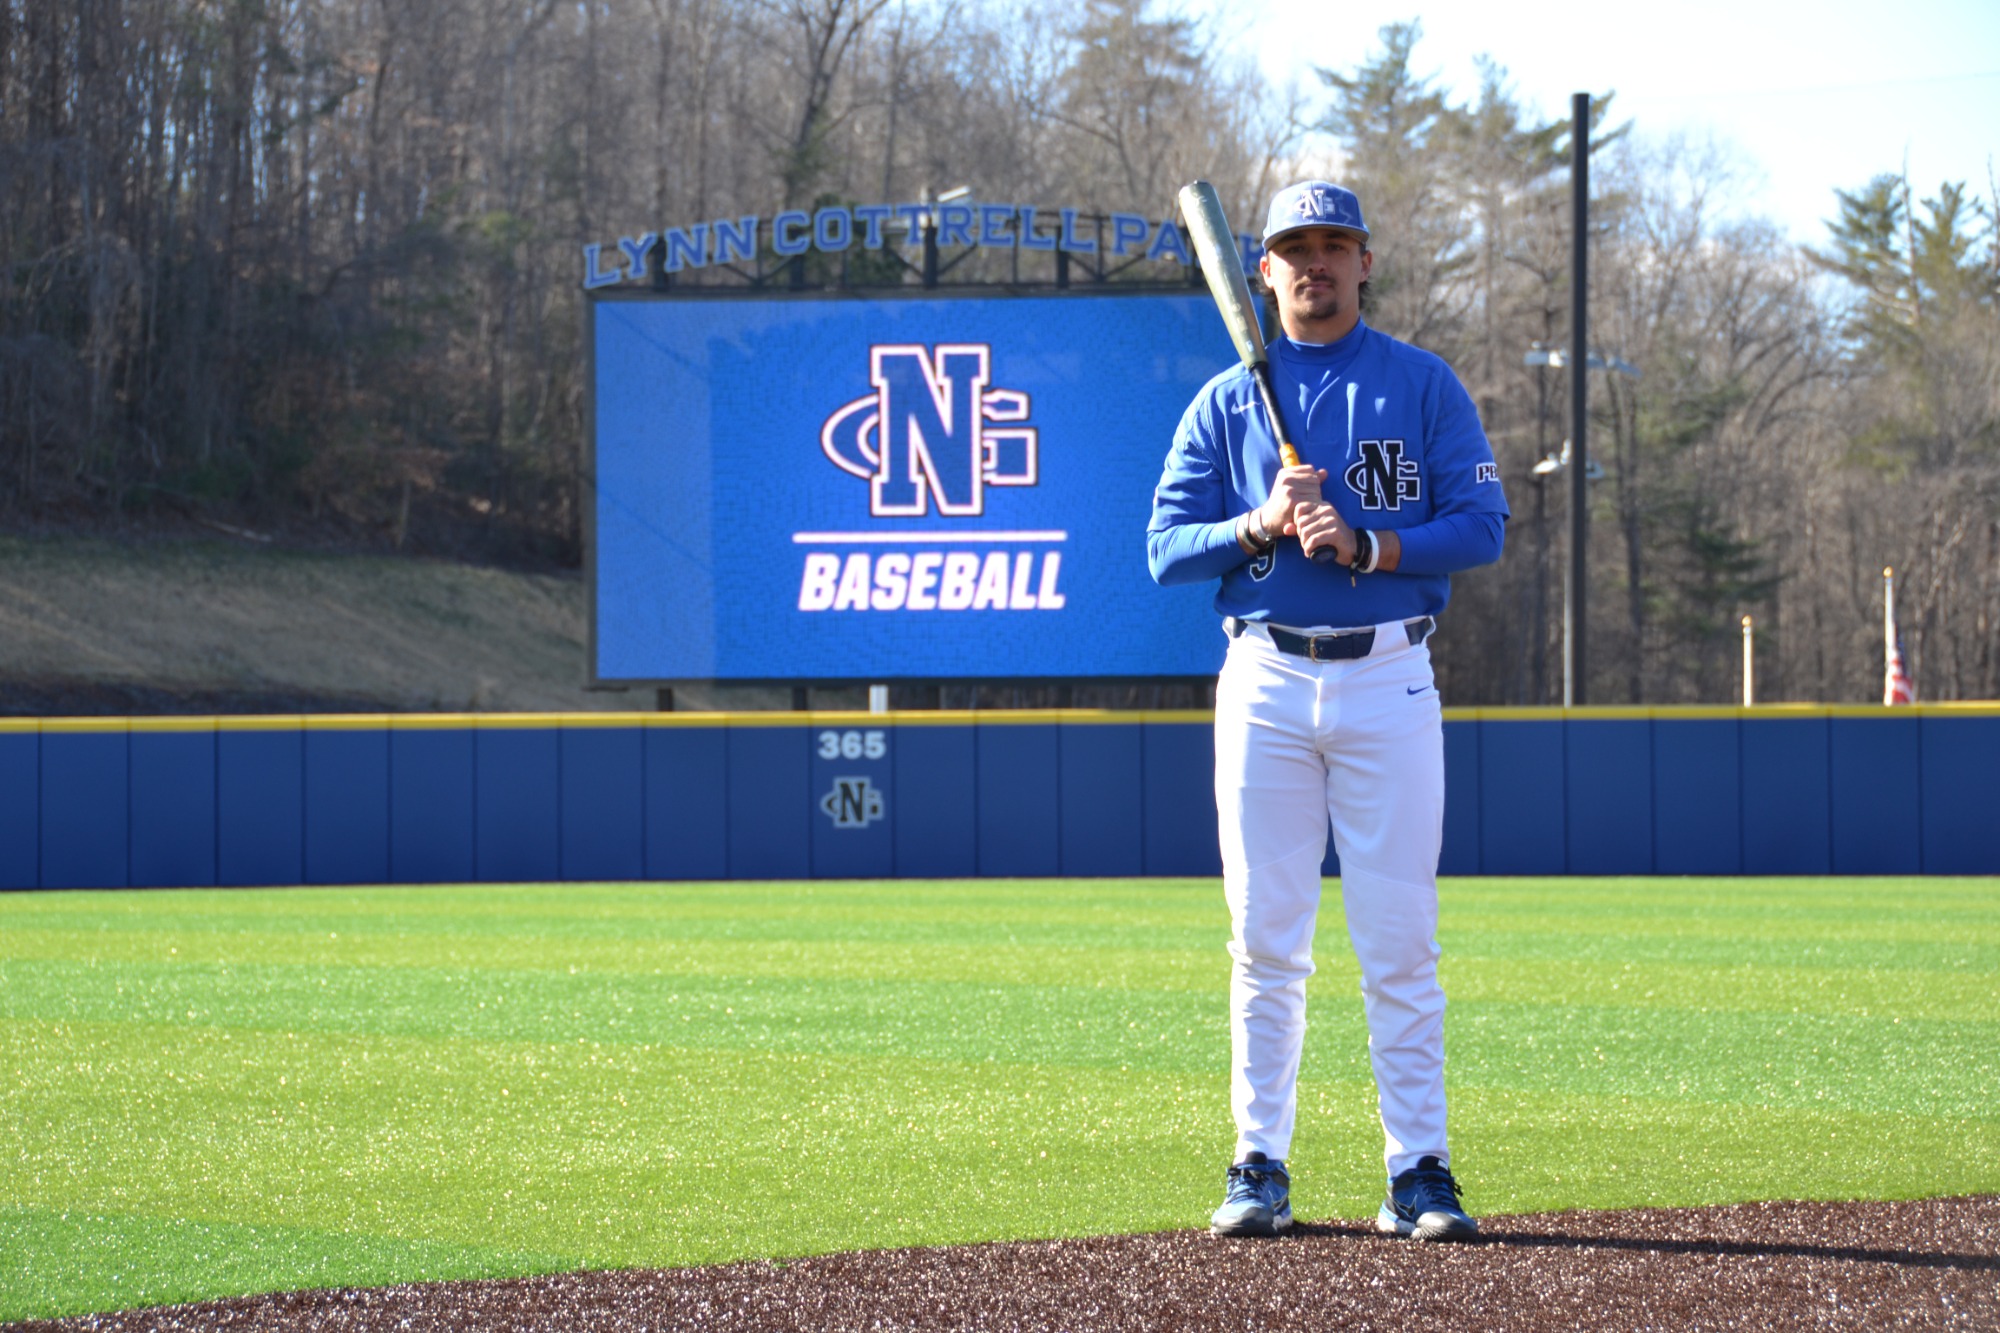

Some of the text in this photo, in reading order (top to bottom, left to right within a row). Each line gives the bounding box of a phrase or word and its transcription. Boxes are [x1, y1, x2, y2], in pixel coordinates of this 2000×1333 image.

[583, 205, 1264, 289] LYNN COTTRELL PAK
[798, 551, 1066, 611] BASEBALL
[818, 730, 887, 760] 365
